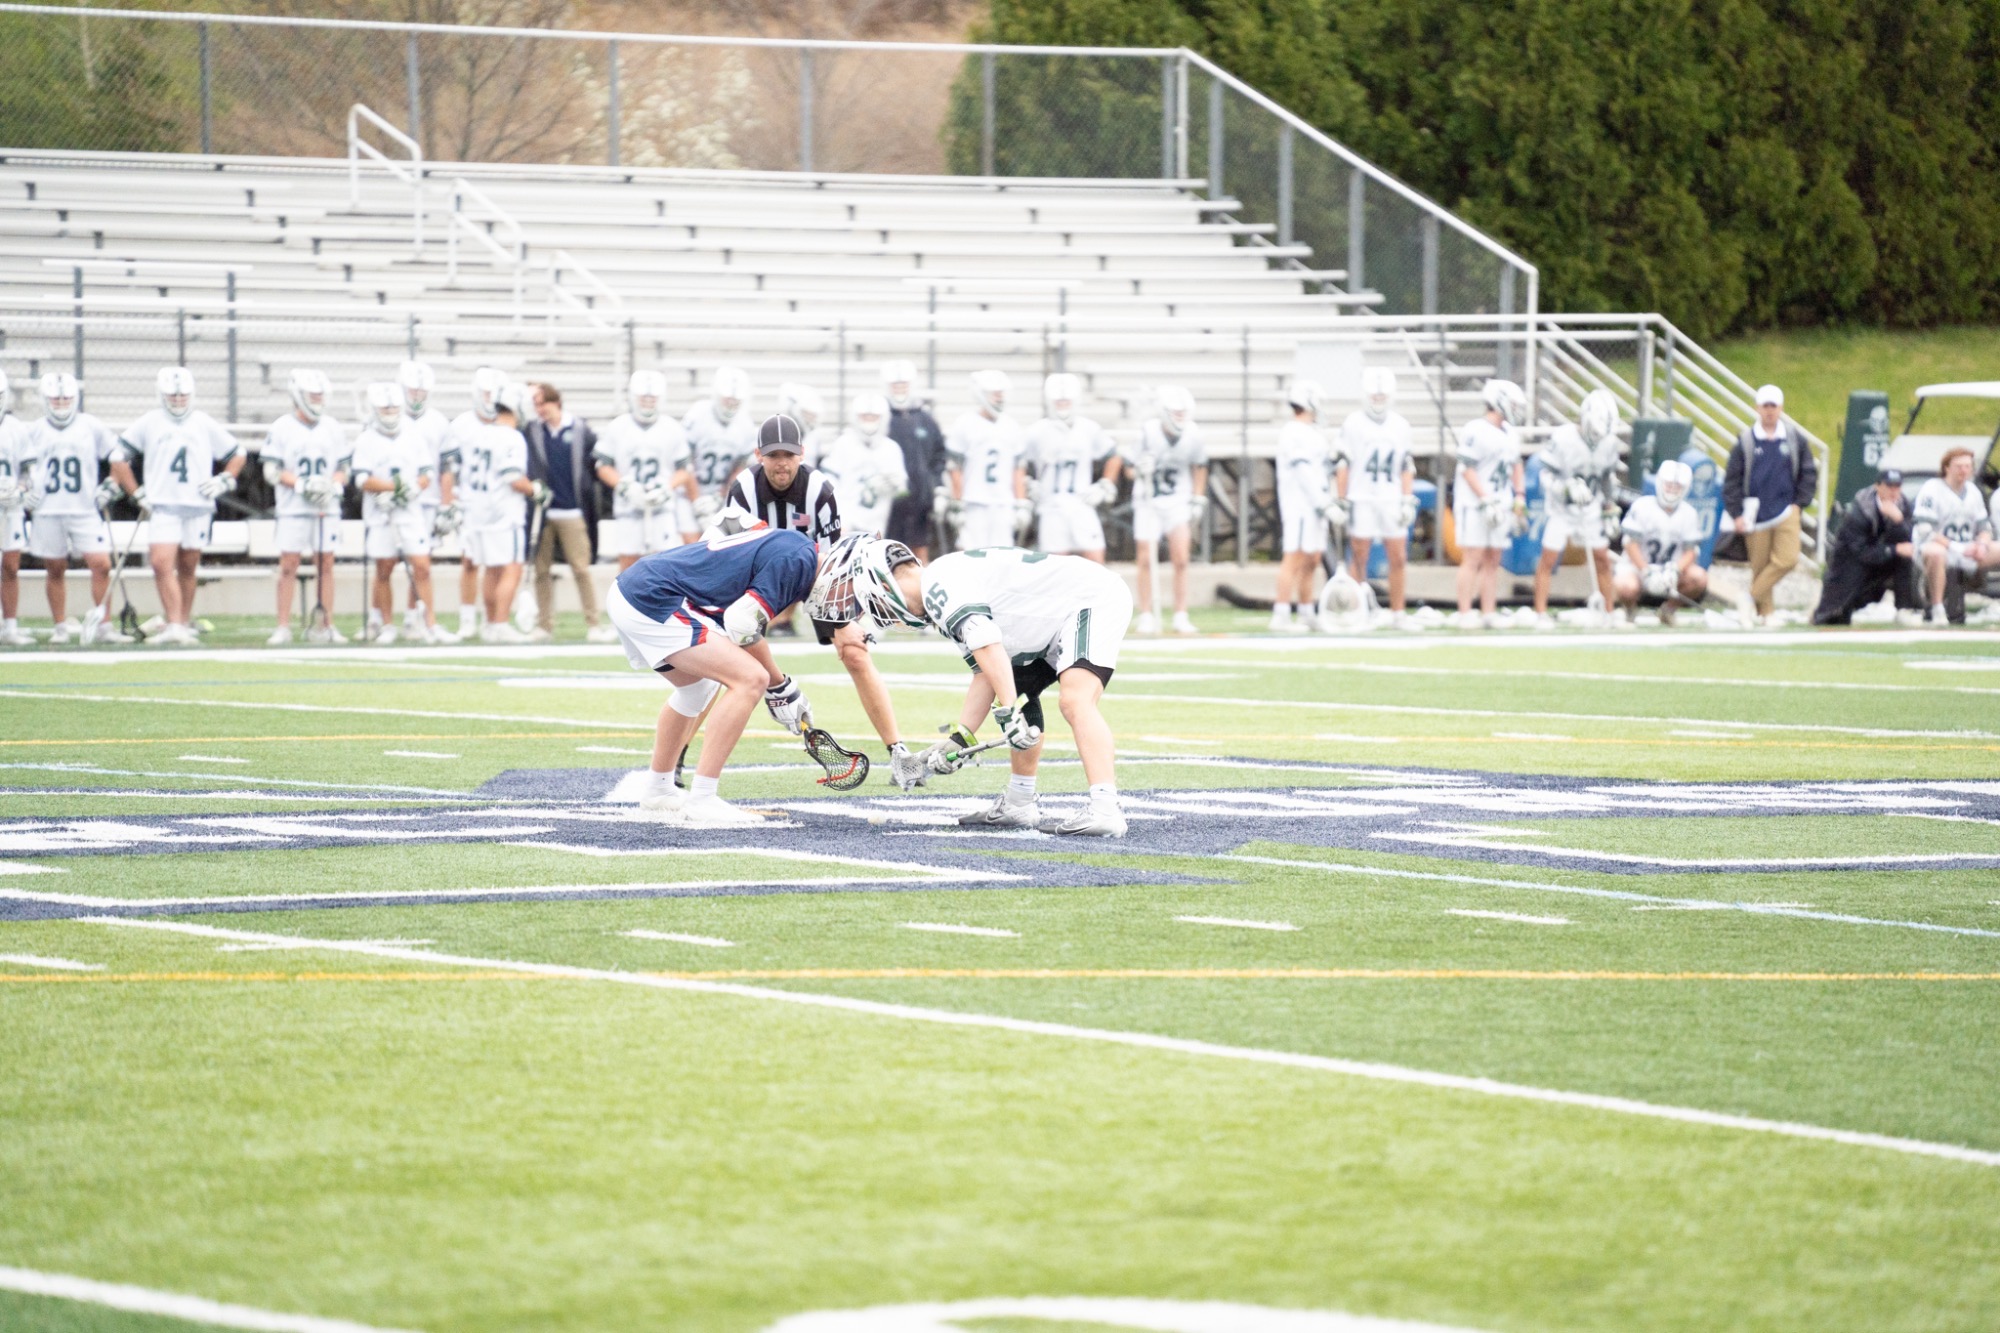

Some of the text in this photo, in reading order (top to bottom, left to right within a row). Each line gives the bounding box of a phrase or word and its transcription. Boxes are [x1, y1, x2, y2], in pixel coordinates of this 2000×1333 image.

[45, 456, 81, 493] 39
[169, 446, 188, 483] 4
[1365, 449, 1394, 482] 44
[925, 582, 948, 619] 35
[769, 697, 788, 707] STX
